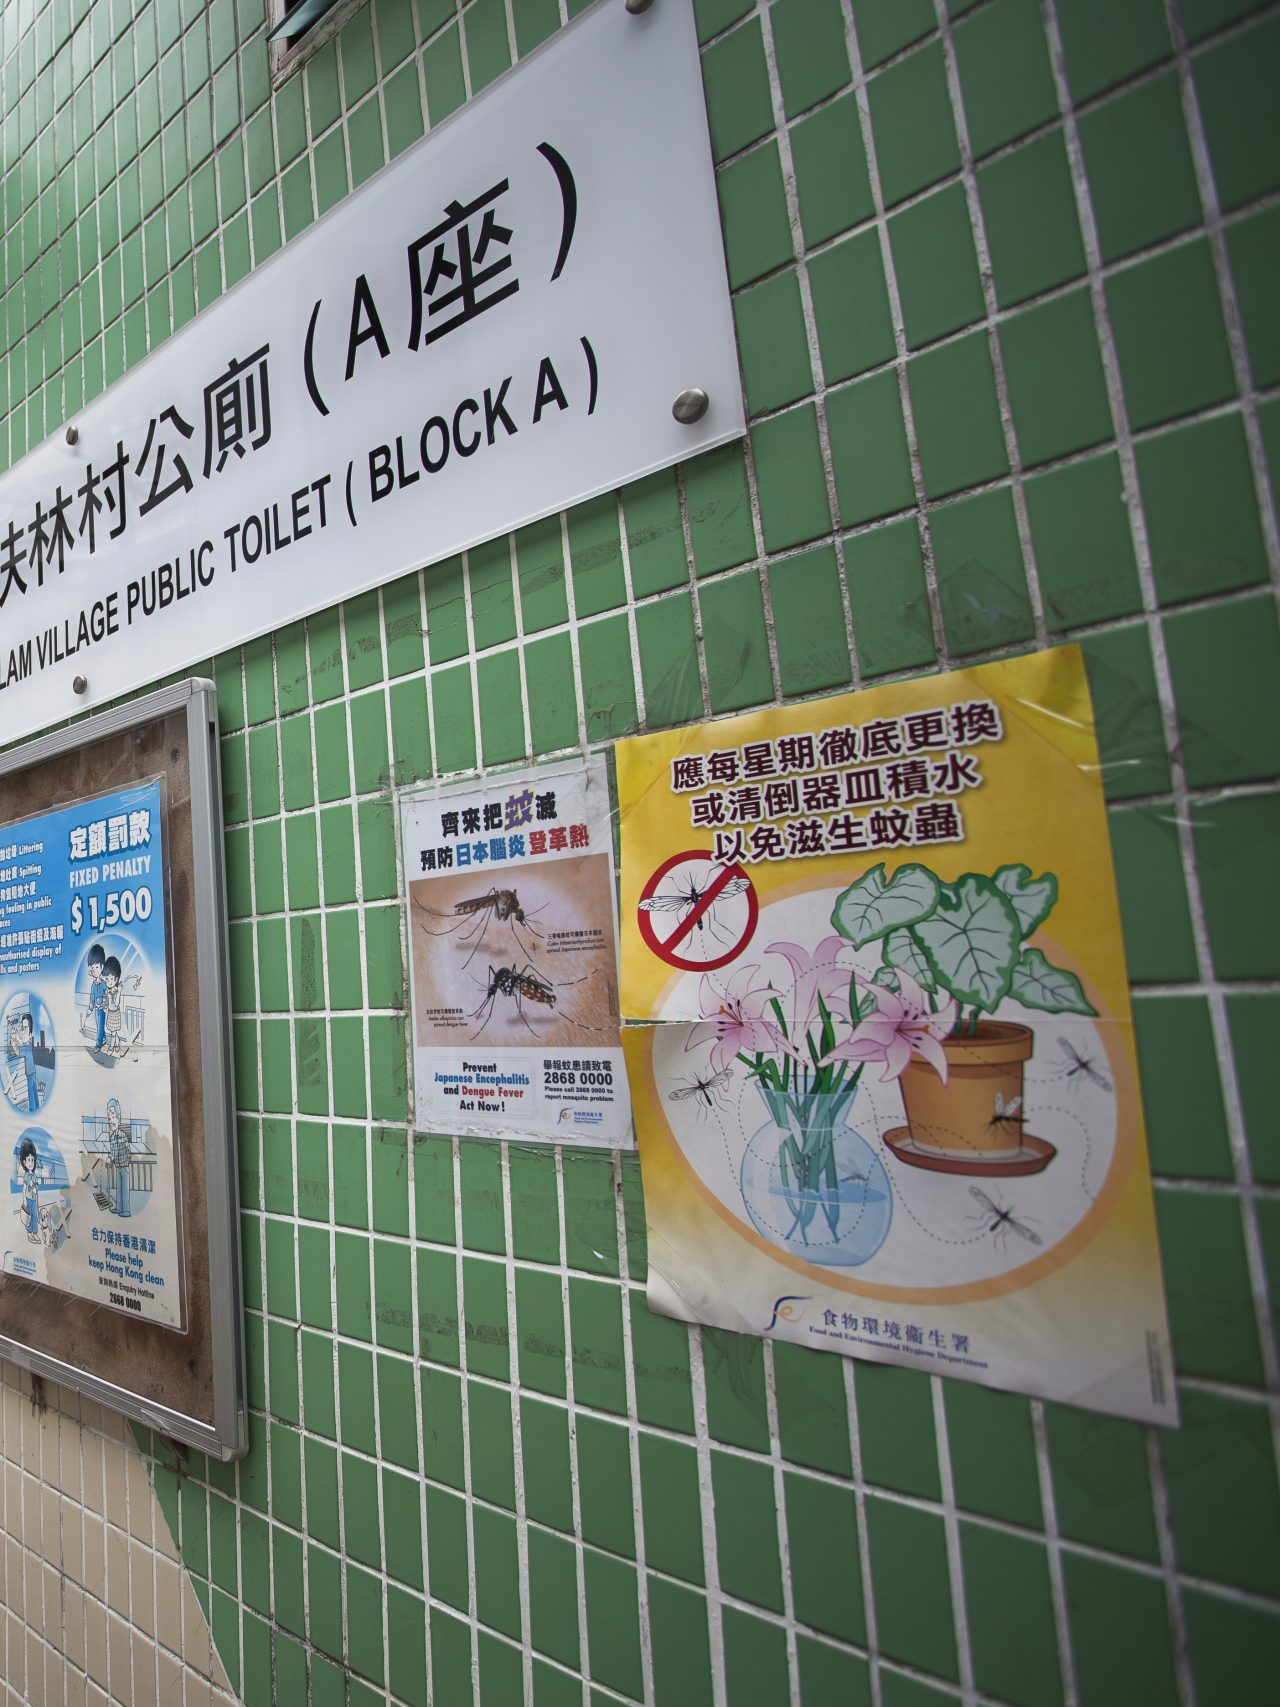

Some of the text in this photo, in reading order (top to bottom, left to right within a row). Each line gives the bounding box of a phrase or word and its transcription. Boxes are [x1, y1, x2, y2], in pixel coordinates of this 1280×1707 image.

[36, 592, 120, 670] VILLAGE
[127, 540, 215, 625] PUBLIC
[224, 474, 331, 573] TOILET
[672, 701, 999, 789] 應每星期徹底更換
[692, 753, 978, 826] 或清倒器皿積水
[441, 789, 557, 838] 齊來把蚊滅
[70, 809, 151, 861] 定額罰款
[714, 803, 960, 863] 以免滋生蚊蟲
[19, 841, 43, 856] Littering
[20, 864, 42, 879] Spitting
[70, 855, 151, 888] FIXED PENALTY
[6, 902, 25, 914] fouling
[27, 900, 32, 910] in
[34, 896, 52, 911] public
[32, 945, 53, 958] display
[55, 943, 61, 954] of
[8, 962, 17, 973] and
[19, 962, 39, 975] posters
[462, 1061, 497, 1073] Prevent
[543, 1060, 612, 1071] 舉報蚊患請致電
[434, 1072, 530, 1085] Japanese Encephalitis
[544, 1072, 612, 1085] 2868 0000
[443, 1085, 524, 1099] and Dengue Fever
[460, 1099, 474, 1111] Act
[92, 1227, 156, 1254] 合力保持香港清潔
[105, 1248, 143, 1270] Please help
[89, 1255, 164, 1286] keep Hong Kong clean
[119, 1283, 137, 1296] Enquiry
[138, 1288, 155, 1299] Hotline
[110, 1292, 141, 1311] 2868 0000
[809, 1326, 988, 1369] Food and Environmental Hygiene Department
